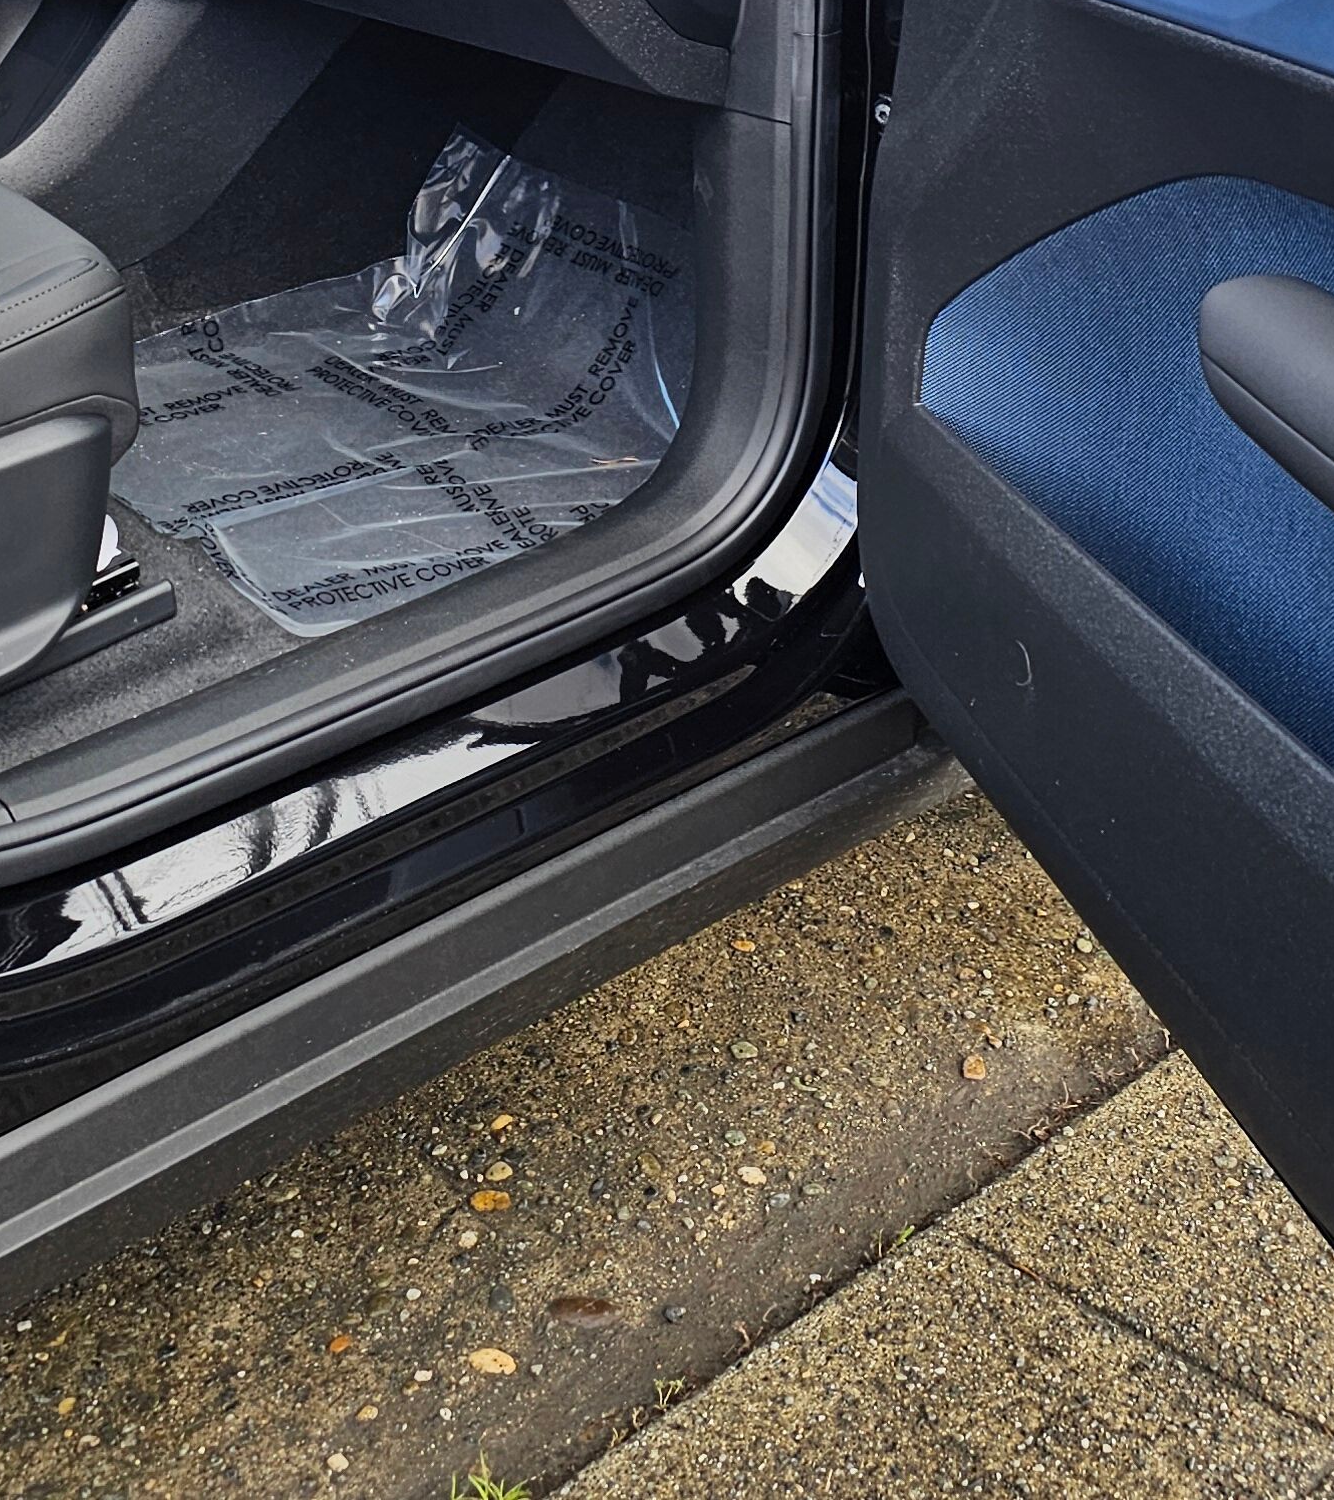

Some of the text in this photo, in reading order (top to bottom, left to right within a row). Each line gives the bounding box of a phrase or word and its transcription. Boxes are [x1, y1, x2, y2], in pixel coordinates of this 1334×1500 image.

[475, 247, 524, 313] DEALER
[570, 250, 613, 275] MUST
[544, 384, 589, 418] MUST
[588, 296, 639, 376] REMOVE
[589, 340, 636, 405] COVER
[163, 385, 248, 410] REMOVE
[305, 366, 392, 408] PROTECTIVE
[379, 383, 424, 405] MUST
[155, 403, 226, 423] COVER
[257, 459, 373, 496] ROTECTIVE
[181, 489, 258, 513] COVER
[484, 507, 536, 549] EALER
[271, 572, 355, 601] DEALER
[288, 573, 416, 611] PROTECTIVE
[416, 556, 491, 582] COVER
